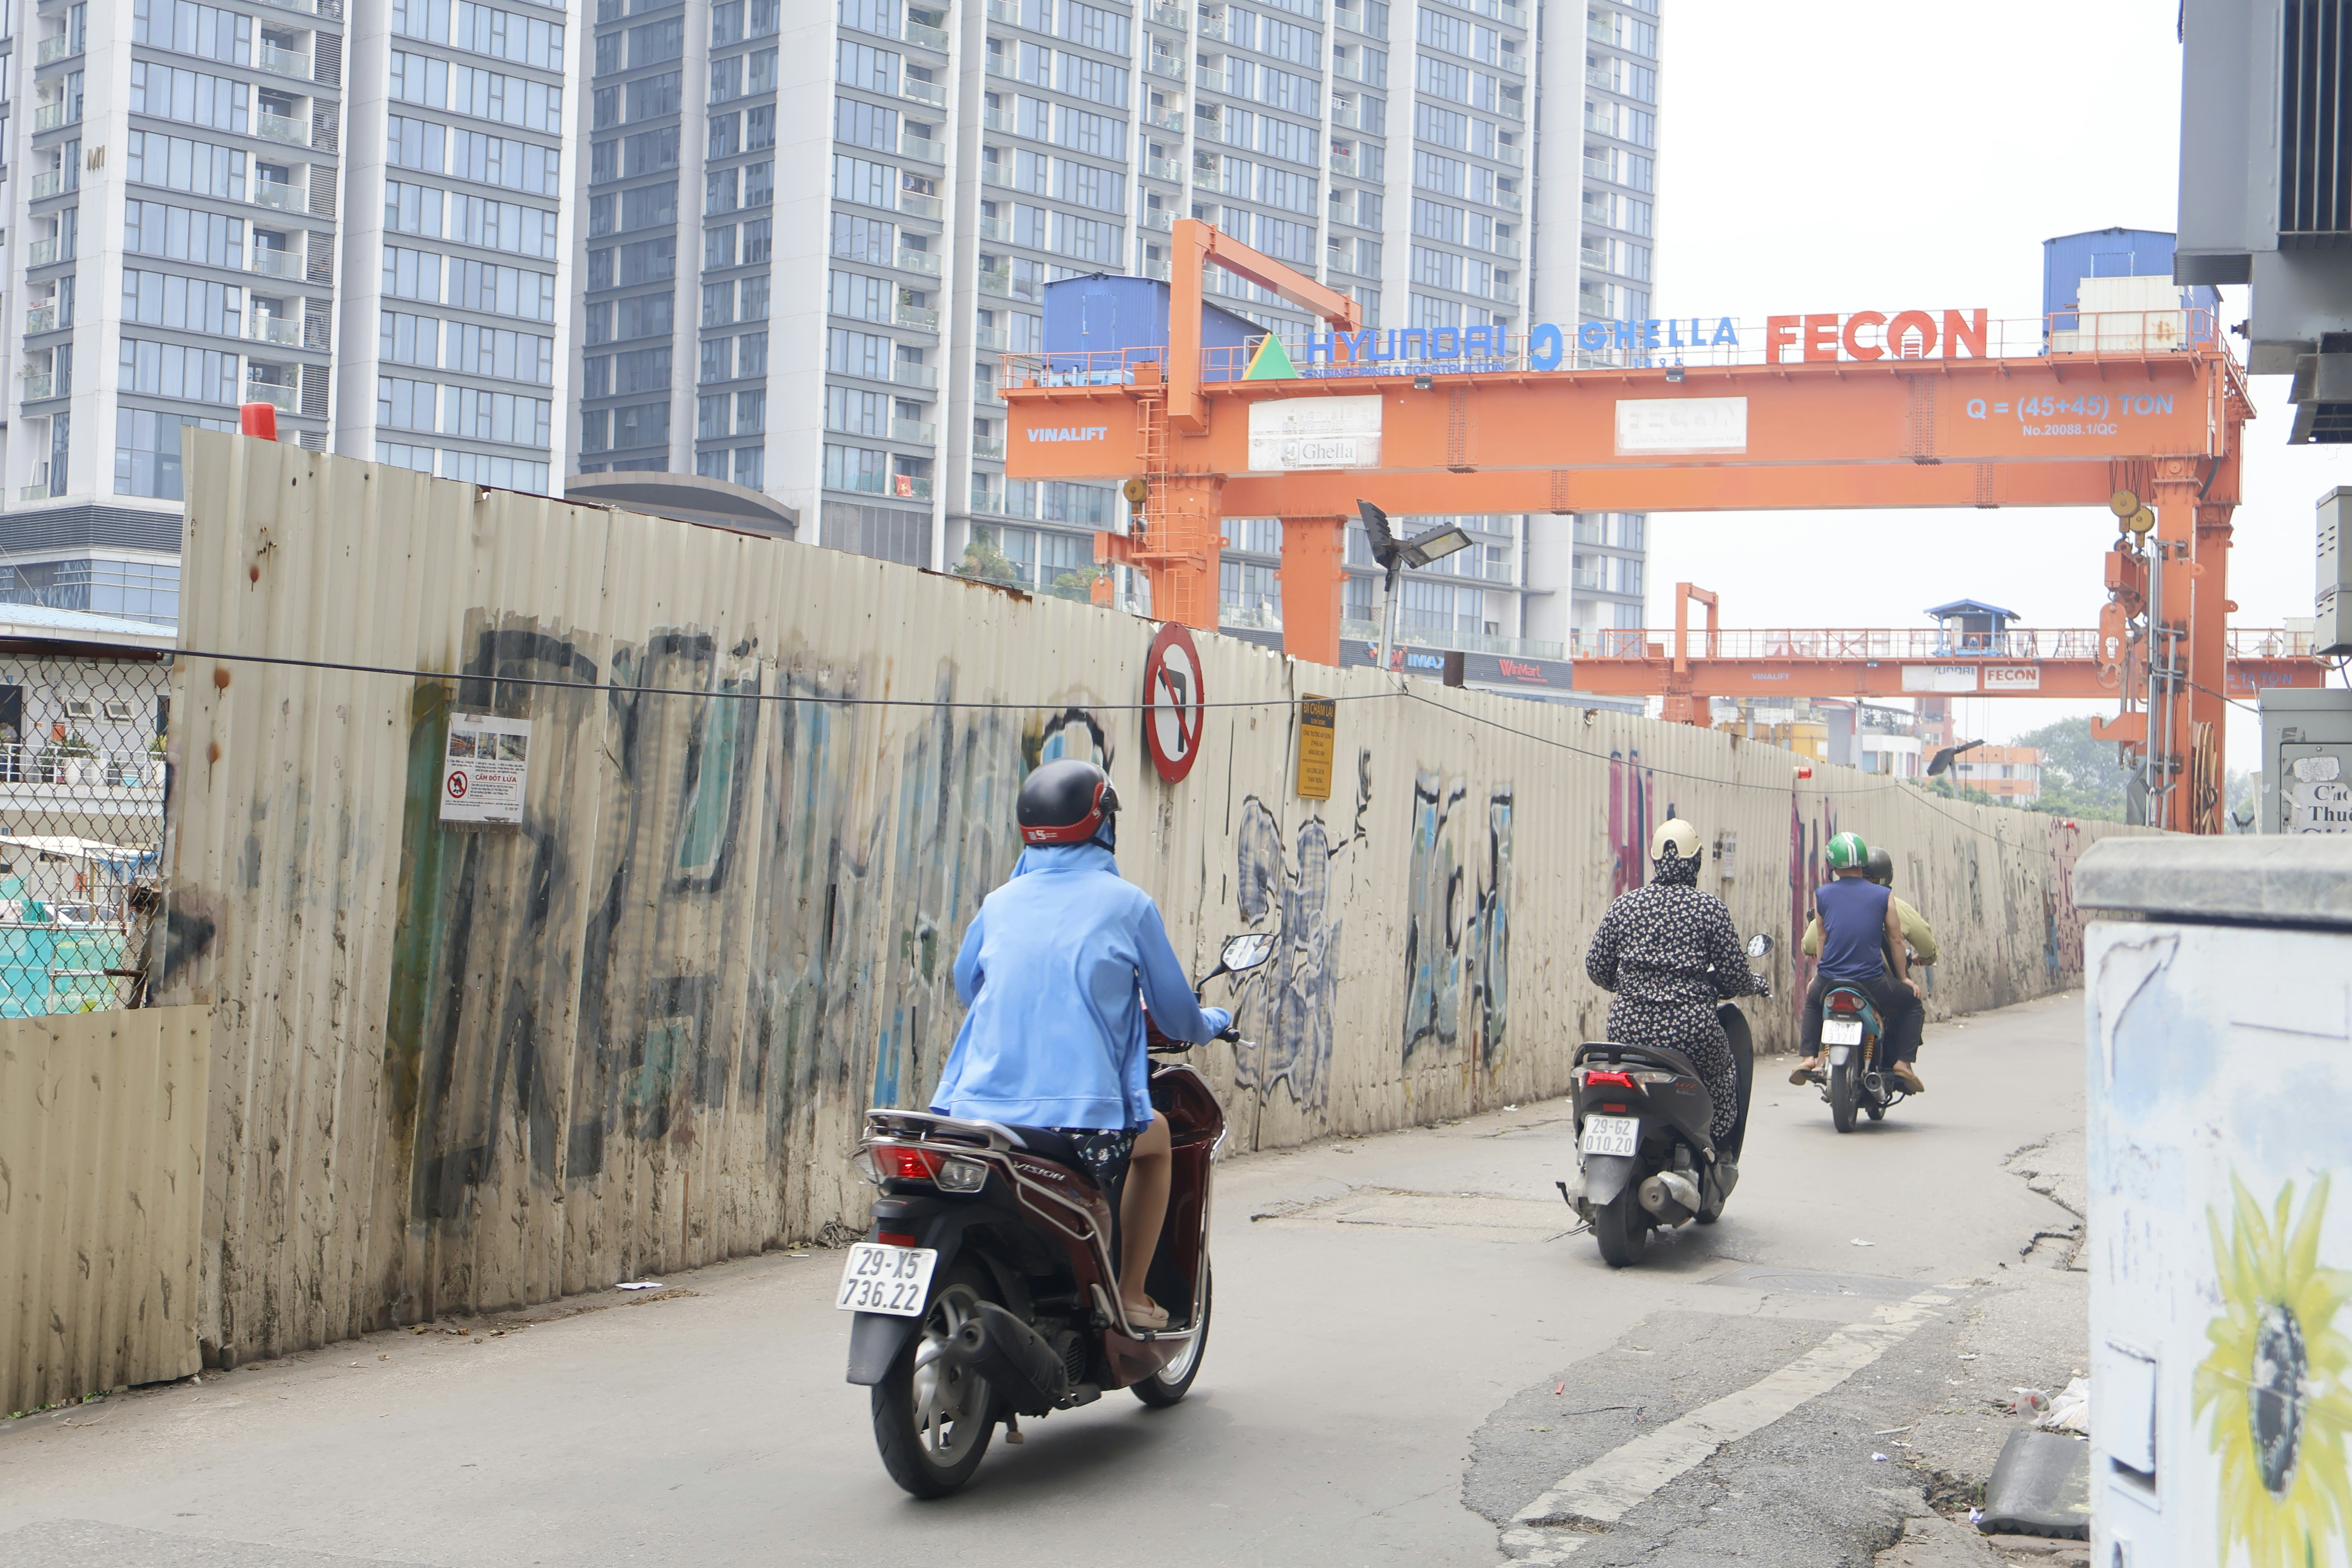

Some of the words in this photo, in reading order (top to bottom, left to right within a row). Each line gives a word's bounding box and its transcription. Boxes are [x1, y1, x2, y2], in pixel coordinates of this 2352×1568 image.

[1579, 317, 1737, 350] GHELLA
[1766, 308, 1988, 363] FECON
[1307, 325, 1506, 363] HYUNDAI
[1305, 366, 1390, 378] ENGINEERING
[1394, 366, 1401, 375] &
[1406, 363, 1506, 374] CONSTRUCTION
[1967, 398, 1986, 420] Q
[2016, 396, 2109, 422] (45+45)
[2118, 394, 2174, 416] TON
[1027, 426, 1107, 442] VINALIFT
[2022, 423, 2118, 436] No.20088.1/QC
[1303, 443, 1353, 459] Ghella
[1499, 659, 1540, 677] WinMart
[1987, 670, 2036, 681] FECON
[1304, 702, 1310, 713] ĐI
[1310, 702, 1325, 718] CHẬM
[1829, 1022, 1856, 1033] 29-Y2
[1828, 1033, 1855, 1043] 3320
[1592, 1119, 1630, 1135] 29-G2
[1586, 1136, 1632, 1152] 010.20
[1013, 1161, 1067, 1181] VISION
[857, 1249, 921, 1278] 29-X5
[844, 1278, 919, 1310] 736.22
